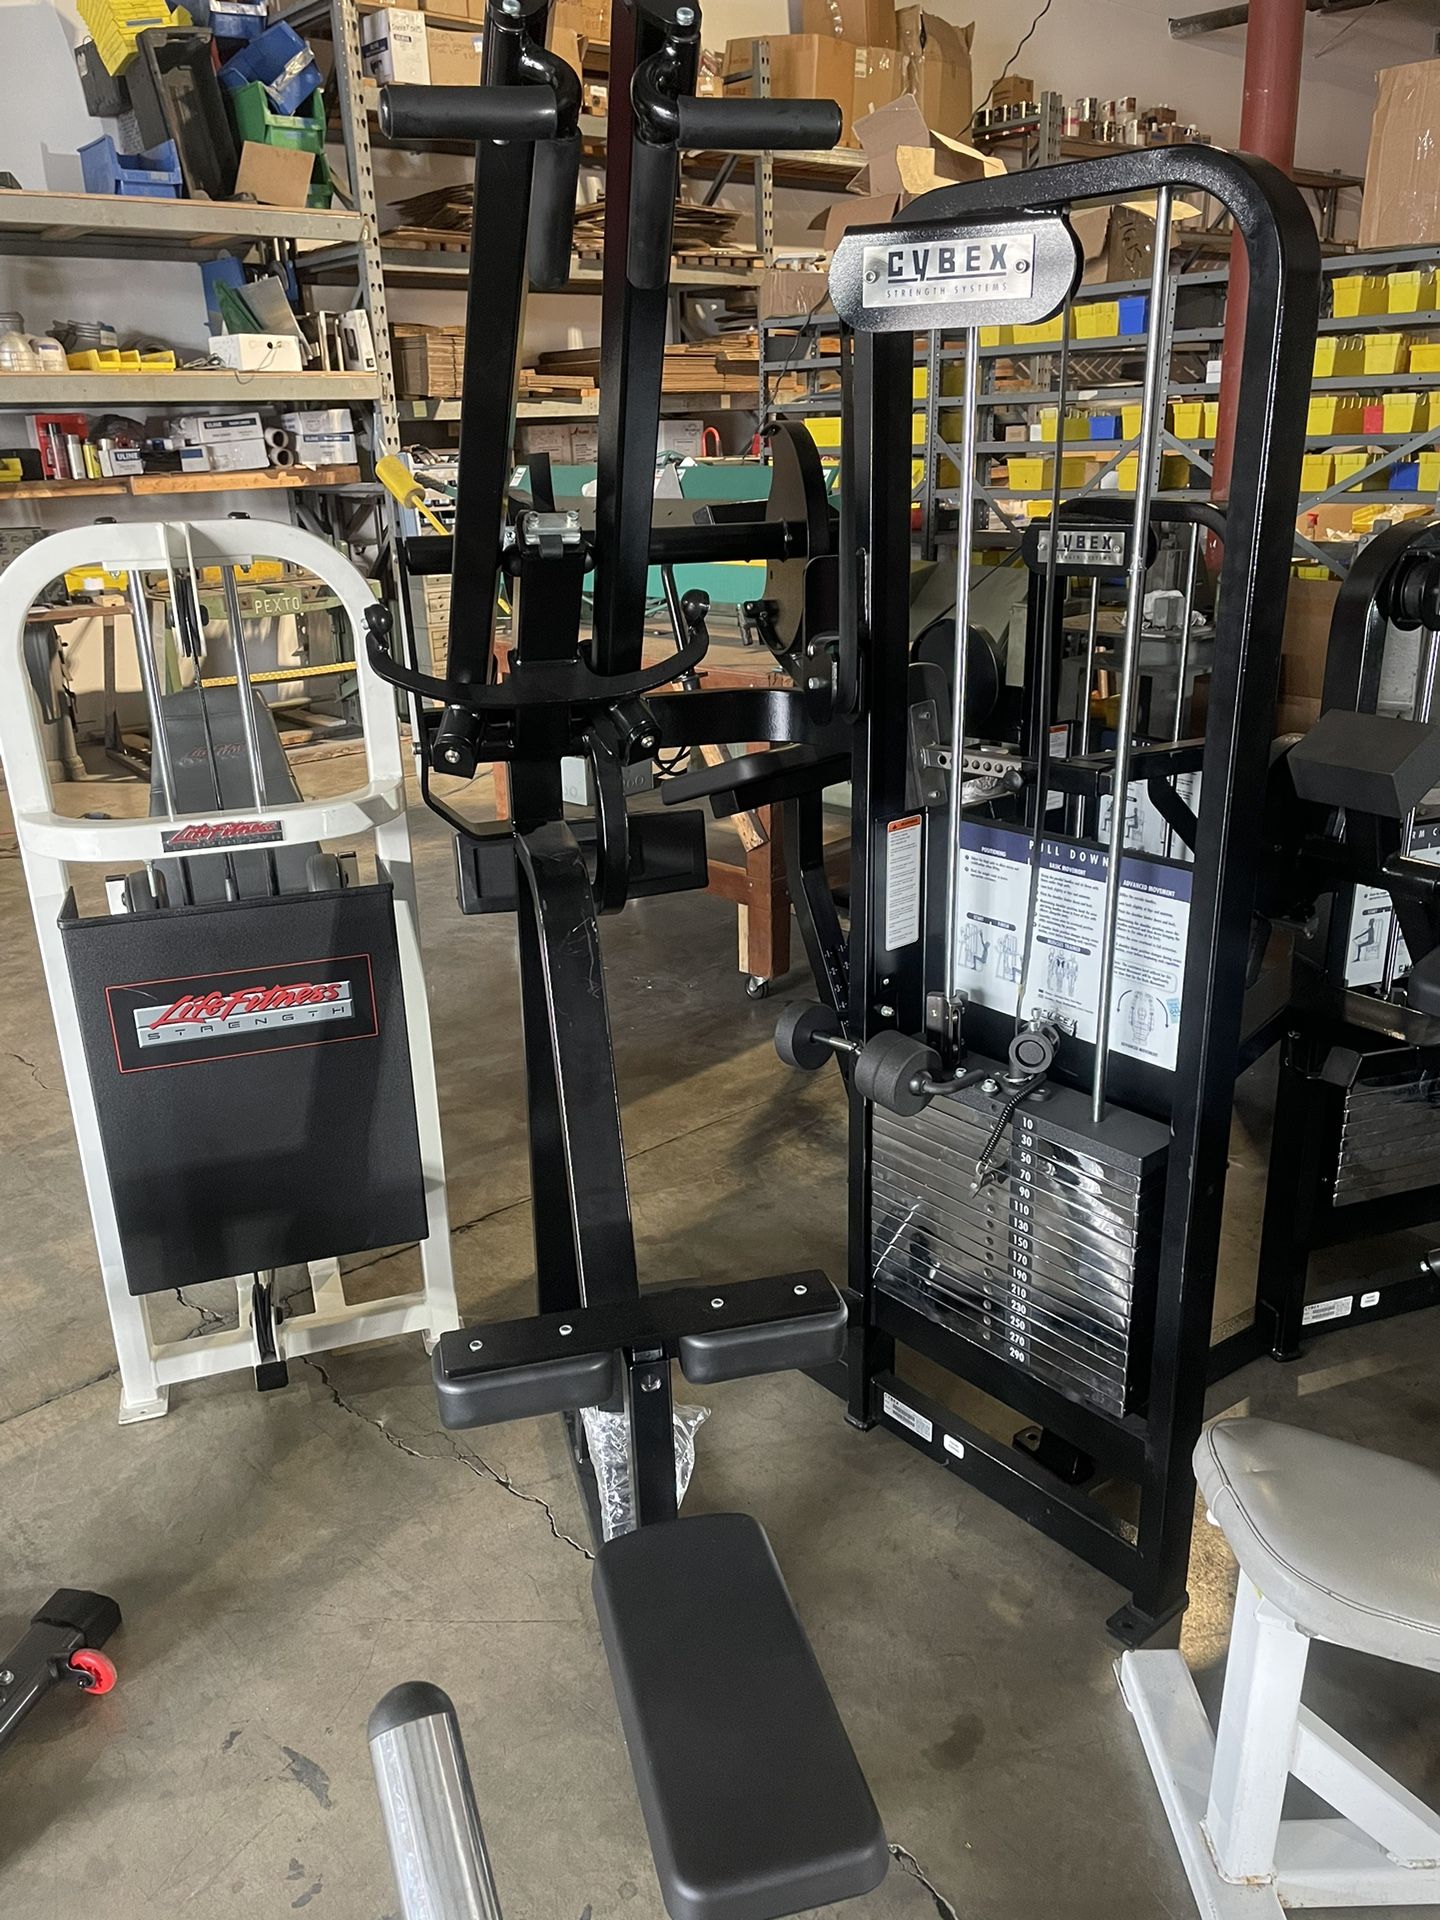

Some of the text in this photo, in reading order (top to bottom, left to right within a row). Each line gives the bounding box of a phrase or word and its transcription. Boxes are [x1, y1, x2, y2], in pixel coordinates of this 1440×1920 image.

[887, 243, 1008, 282] CYBEX
[886, 282, 1008, 299] STRENGTH SYSTEMS
[116, 452, 138, 460] ULINE
[254, 596, 300, 614] PEXTO
[1412, 829, 1425, 839] RM
[1070, 849, 1109, 867] DOWN
[1122, 879, 1148, 891] ADVANCED
[147, 1006, 345, 1041] STRENGTH
[1022, 1117, 1033, 1130] 10
[1021, 1134, 1032, 1148] 30
[1020, 1152, 1032, 1165] 50
[1020, 1169, 1031, 1183] 70
[1019, 1186, 1030, 1200] 90
[1014, 1200, 1029, 1216] 110
[1013, 1218, 1028, 1233] 130
[1013, 1234, 1028, 1250] 150
[1012, 1250, 1028, 1266] 170
[1012, 1267, 1027, 1283] 190
[1011, 1283, 1026, 1299] 210
[1011, 1300, 1026, 1315] 230
[1010, 1315, 1025, 1331] 250
[1009, 1331, 1025, 1347] 270
[1009, 1347, 1024, 1363] 290
